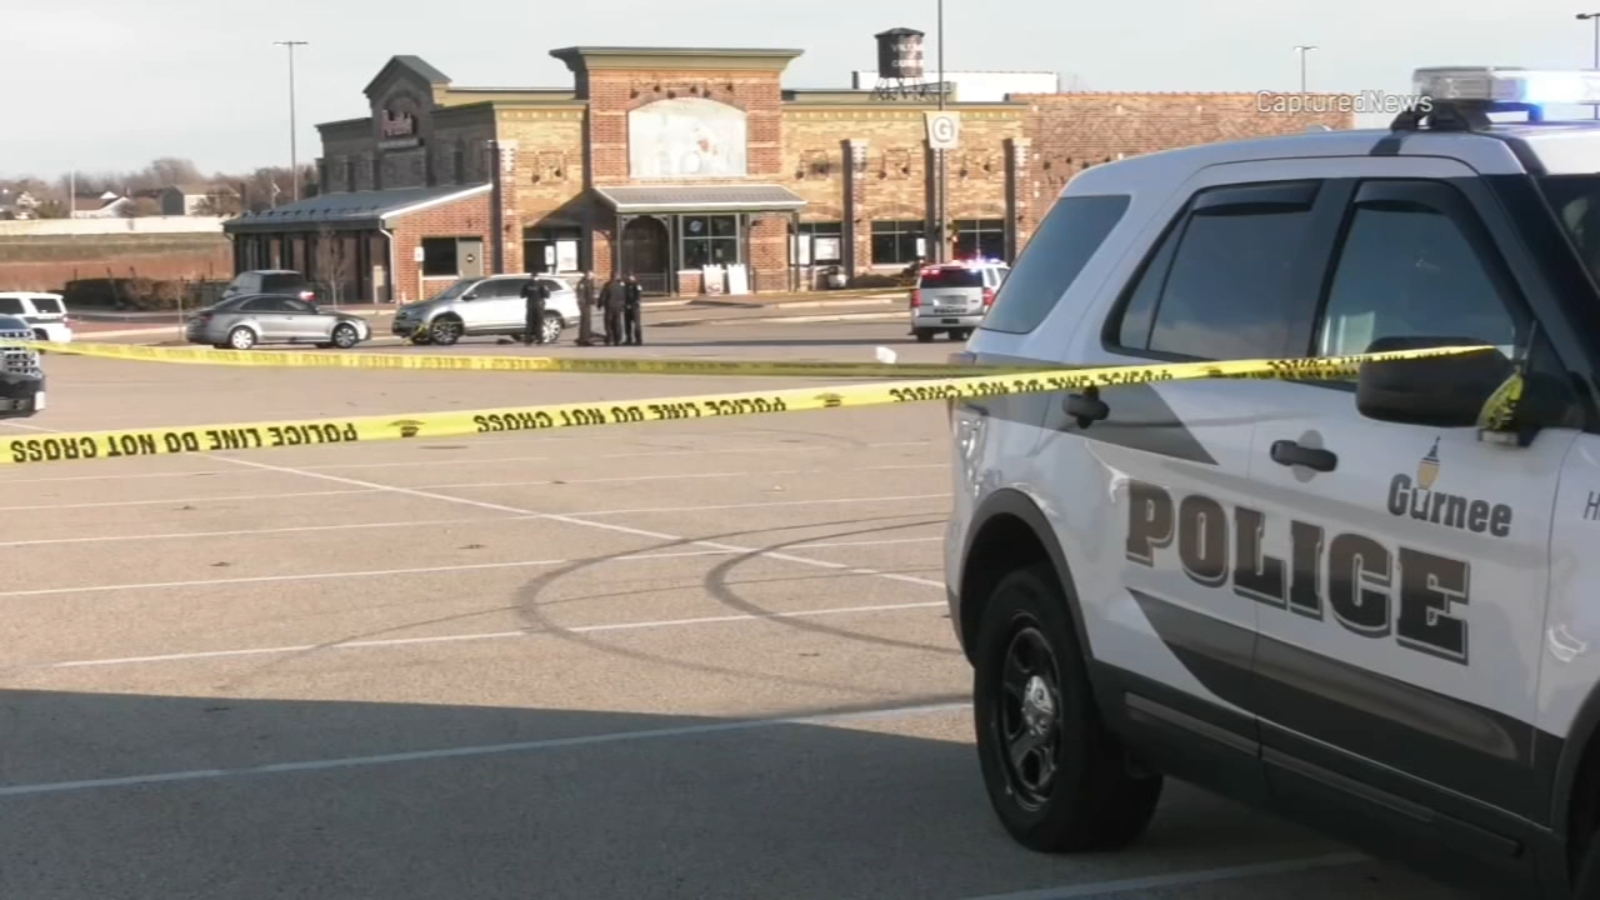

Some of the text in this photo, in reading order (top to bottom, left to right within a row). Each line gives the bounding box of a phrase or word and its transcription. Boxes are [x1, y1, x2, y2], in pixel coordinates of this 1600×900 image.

[934, 118, 953, 142] G
[473, 397, 787, 433] POLICE LINE DO NOT CROSS
[10, 423, 359, 463] POLICE LINE DO NOT CROSS
[1387, 473, 1513, 538] Gurnee
[1125, 479, 1470, 666] POLICE
